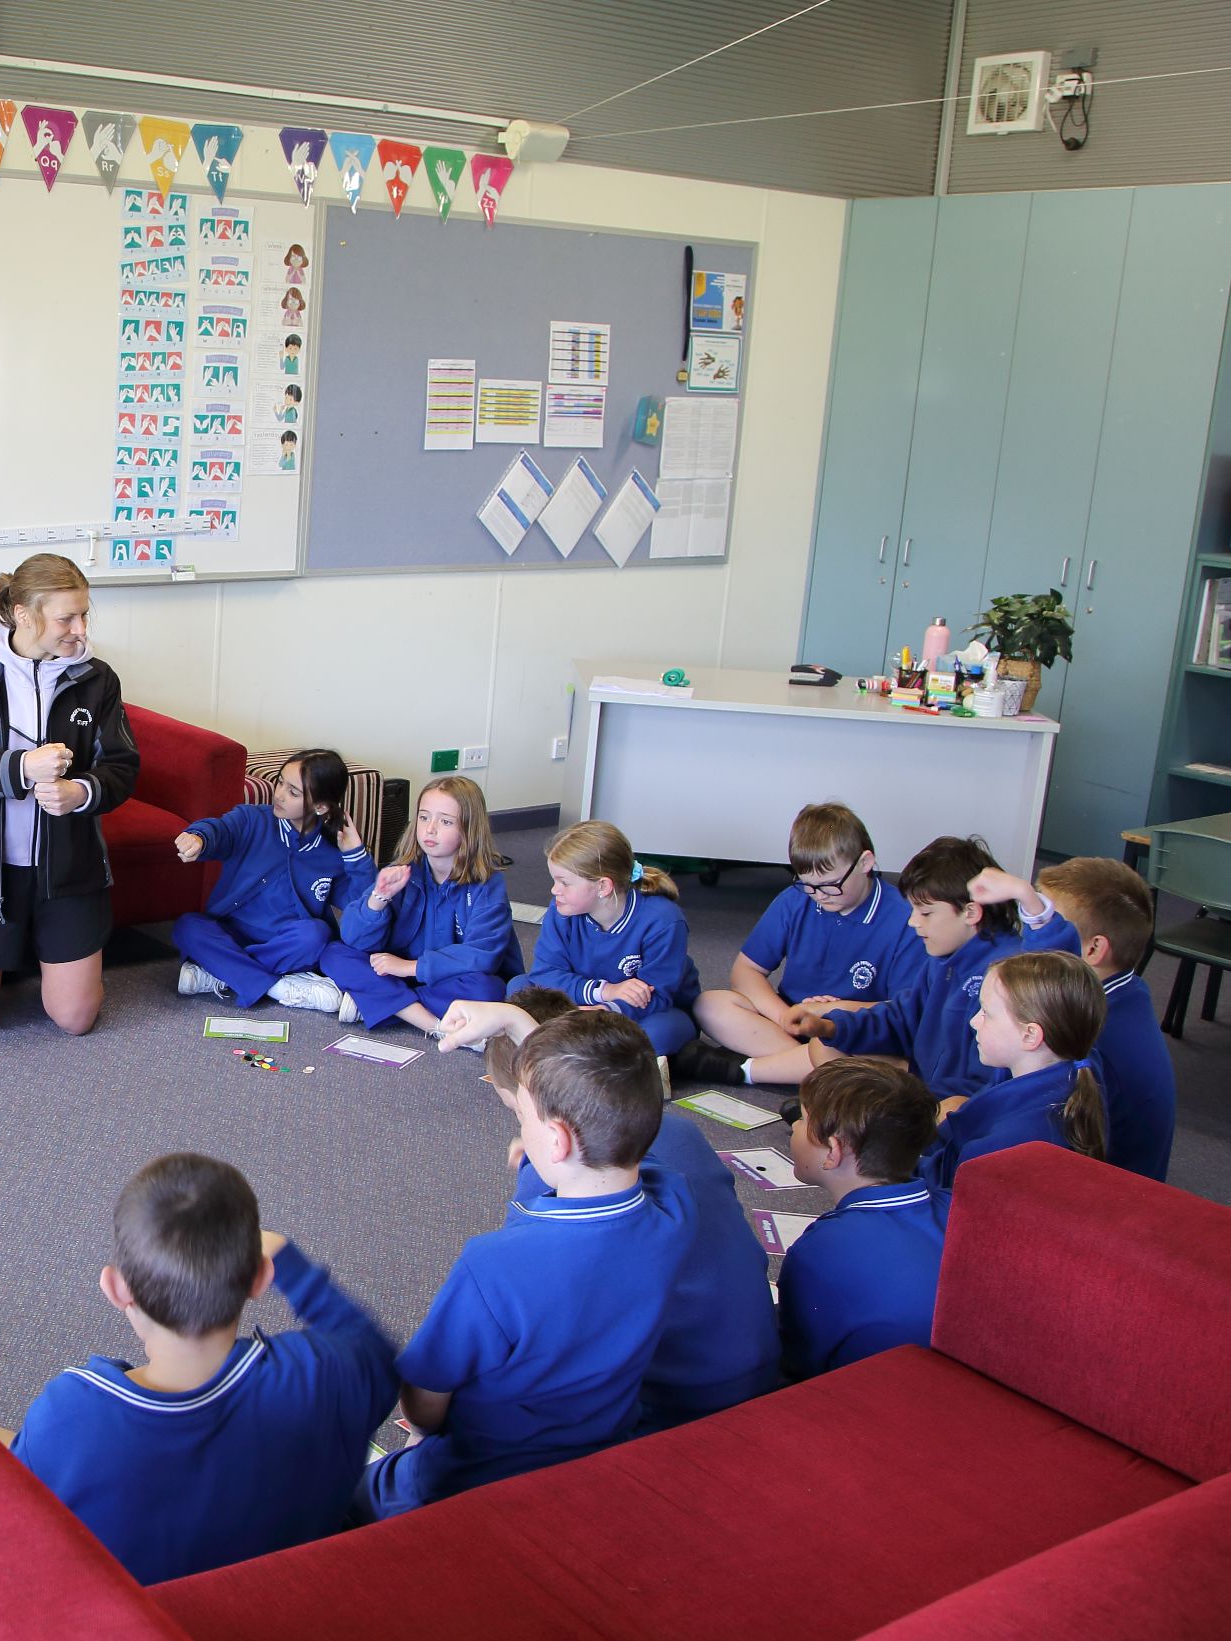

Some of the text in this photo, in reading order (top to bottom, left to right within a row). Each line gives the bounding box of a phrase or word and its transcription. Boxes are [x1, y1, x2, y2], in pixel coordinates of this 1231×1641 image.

[40, 155, 58, 171] Qq
[102, 161, 114, 172] Rr
[157, 166, 170, 178] Ss
[211, 171, 223, 182] Tt
